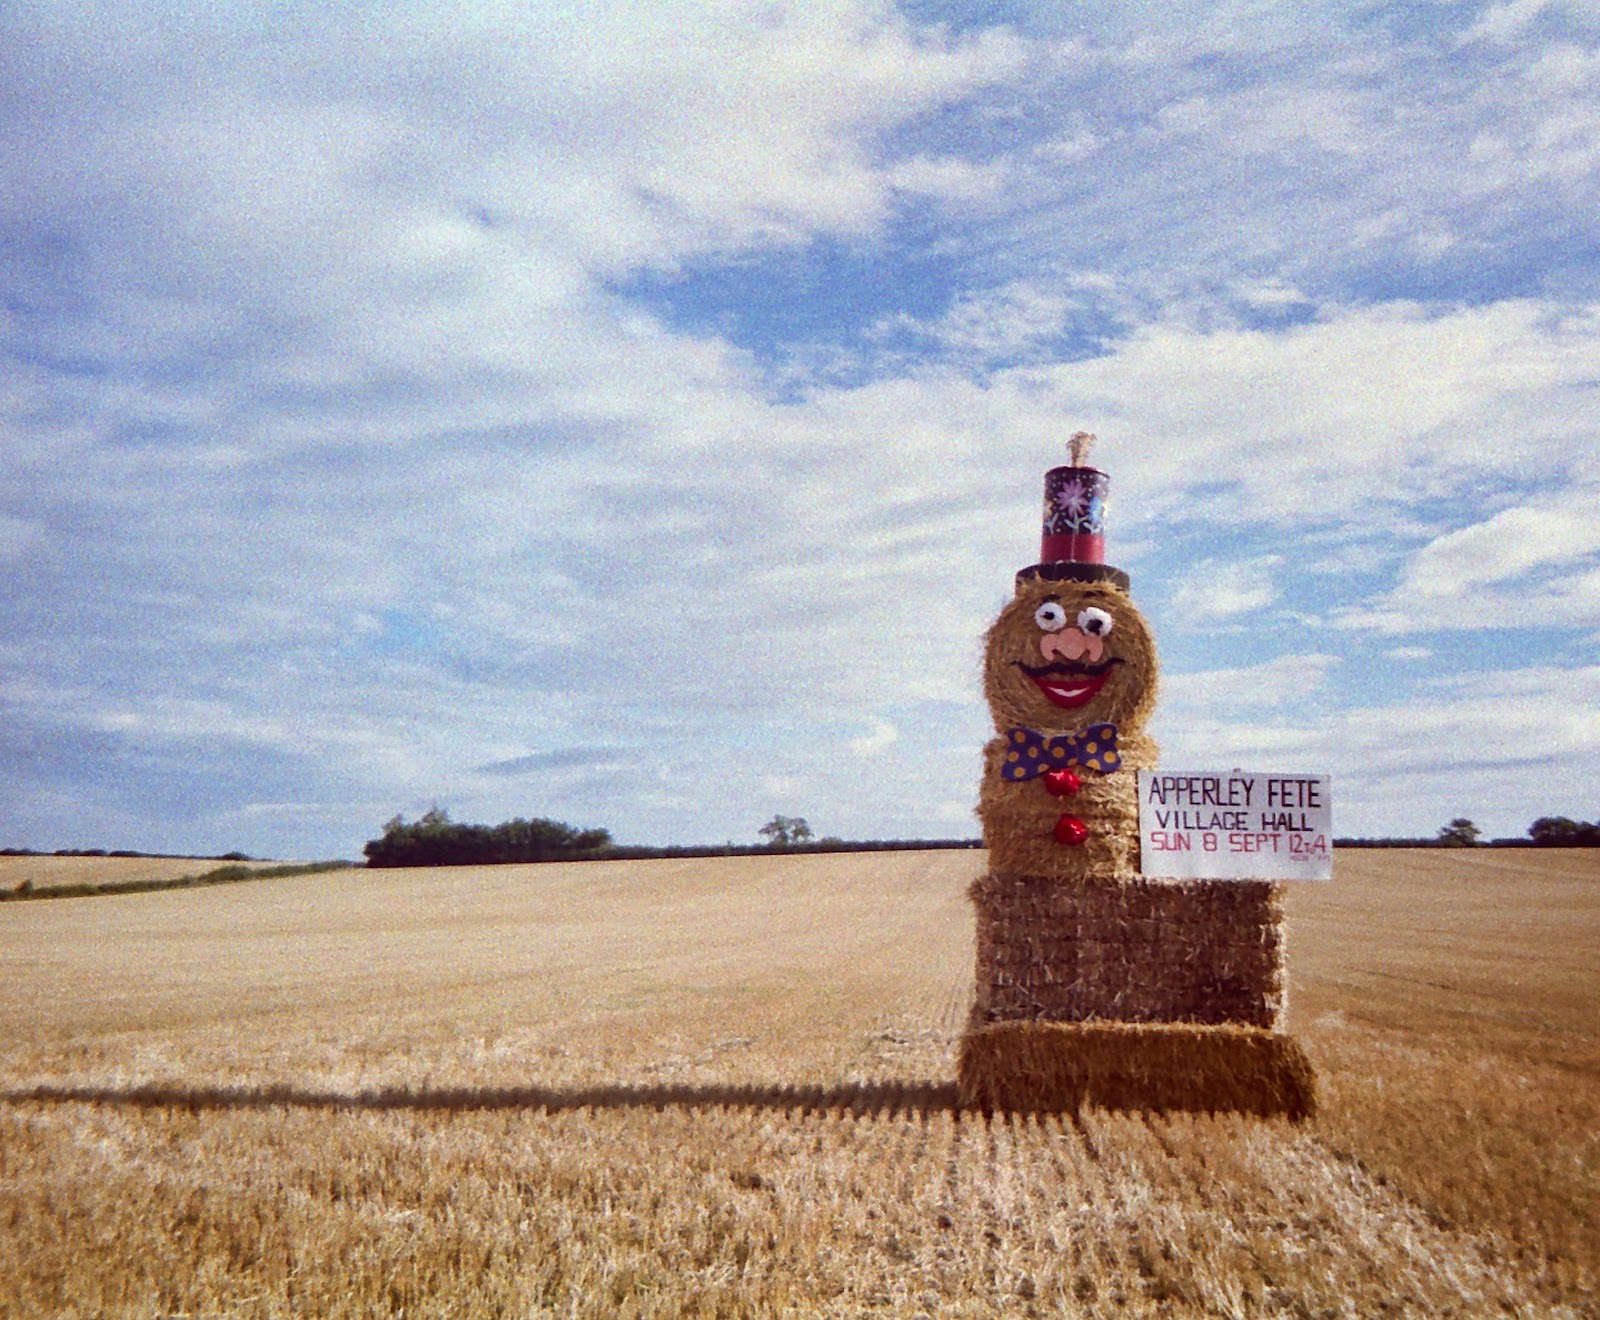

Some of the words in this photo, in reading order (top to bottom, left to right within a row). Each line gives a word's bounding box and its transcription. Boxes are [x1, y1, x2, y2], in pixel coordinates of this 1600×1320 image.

[1149, 776, 1254, 806] APPERLEY
[1267, 779, 1321, 808] FETE
[1155, 810, 1248, 831] VILLAGE
[1262, 812, 1313, 832] HALL
[1151, 831, 1191, 851] SUN
[1202, 832, 1217, 852] 8
[1229, 833, 1281, 853] SEPT
